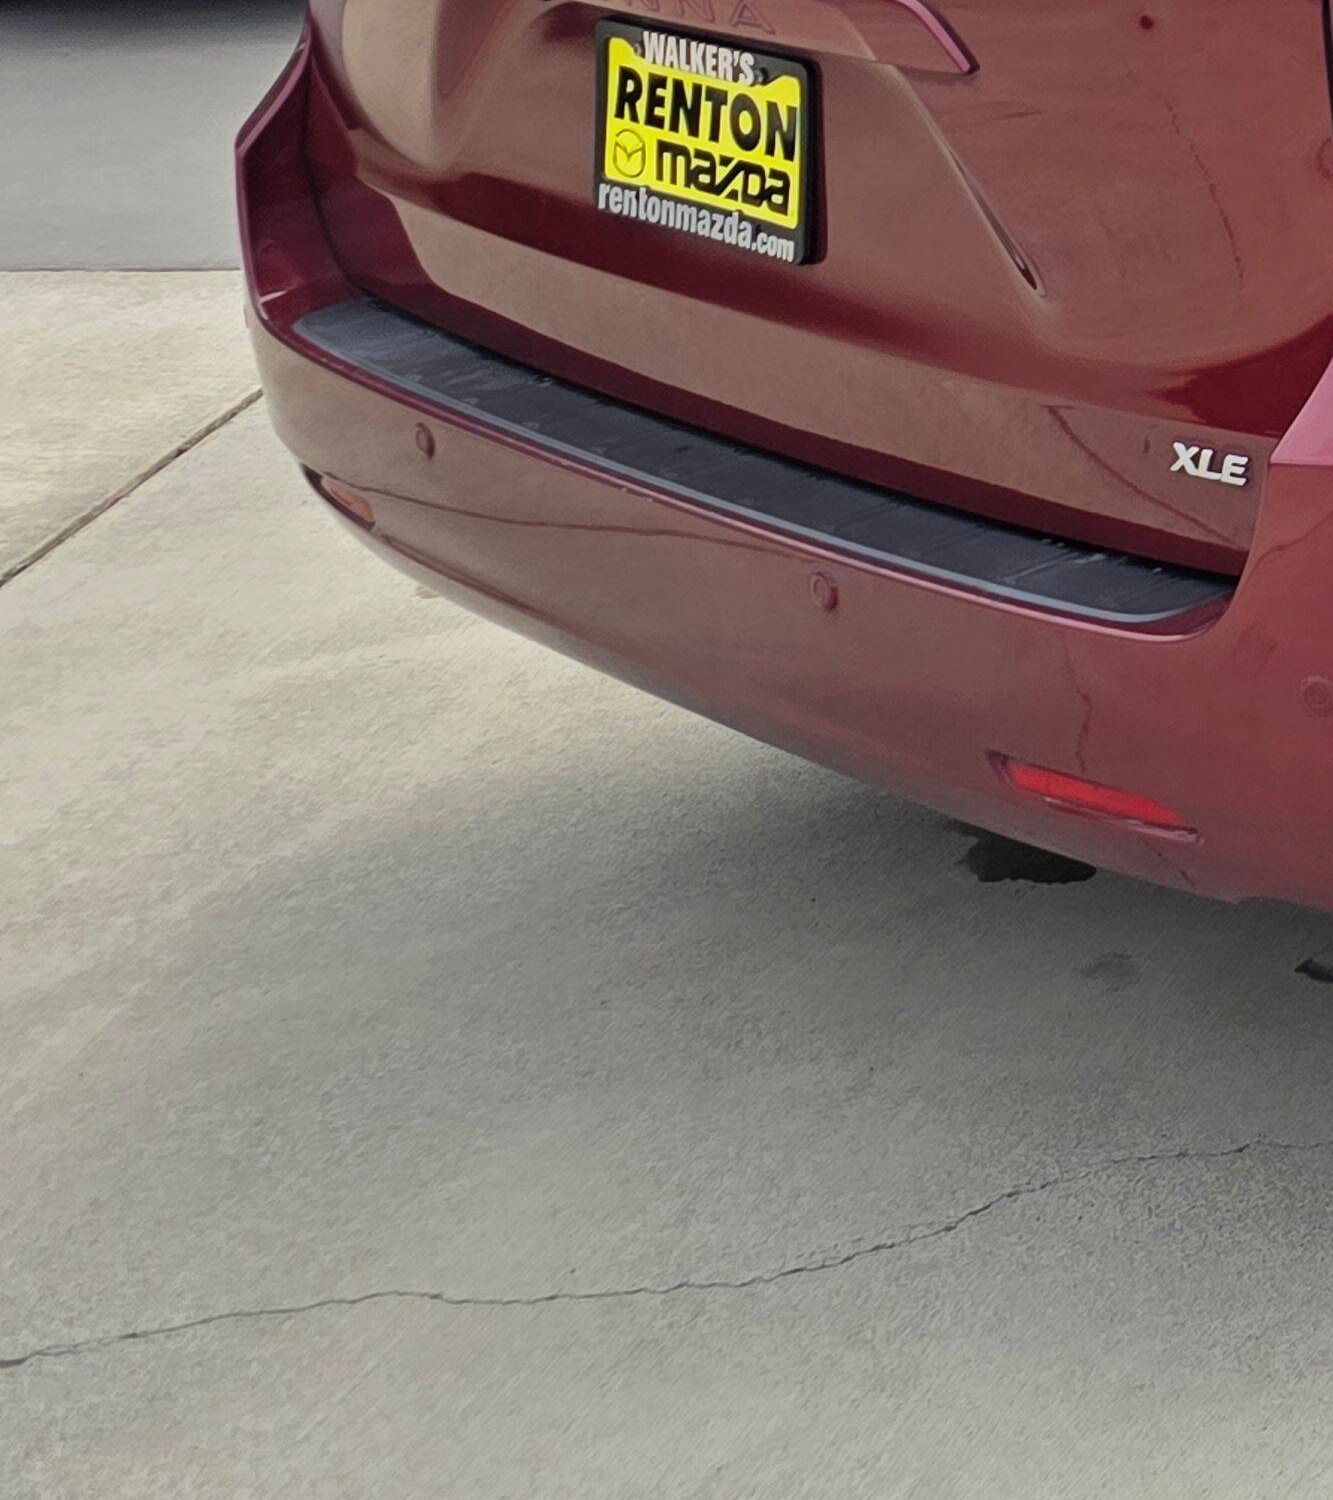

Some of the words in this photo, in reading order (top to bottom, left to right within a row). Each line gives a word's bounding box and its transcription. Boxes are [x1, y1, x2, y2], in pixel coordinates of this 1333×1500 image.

[642, 30, 755, 86] WALKER'S
[614, 65, 798, 162] RENTON
[656, 139, 790, 215] mazda
[597, 182, 796, 263] rentonmazda.com
[1169, 441, 1249, 487] XLE
